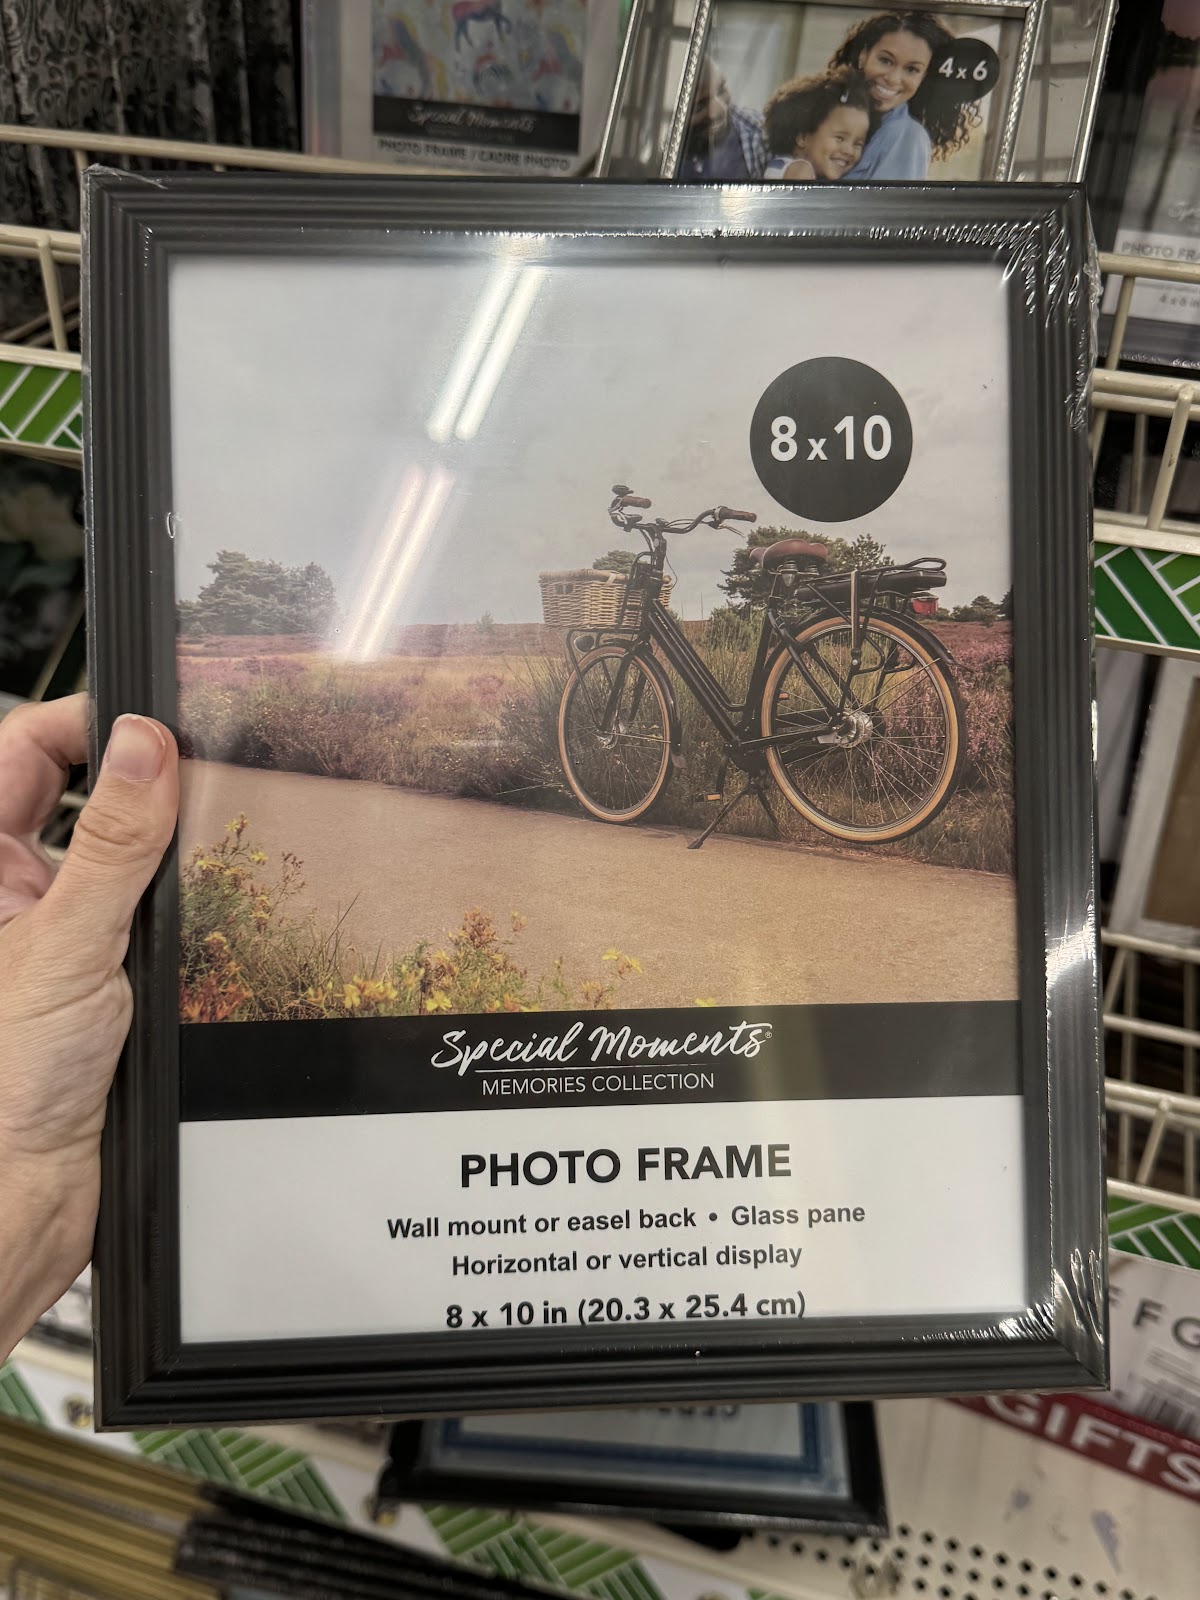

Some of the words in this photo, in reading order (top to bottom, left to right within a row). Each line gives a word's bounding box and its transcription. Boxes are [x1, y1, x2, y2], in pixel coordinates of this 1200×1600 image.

[938, 56, 954, 79] 4
[956, 66, 967, 80] x
[972, 58, 988, 82] 6
[770, 415, 798, 462] 8
[806, 438, 828, 461] x
[833, 414, 892, 461] 10
[430, 1021, 585, 1077] Special
[481, 1076, 587, 1096] MEMORIES
[591, 1072, 715, 1093] COLLECTION
[460, 1147, 622, 1188] PHOTO
[637, 1143, 793, 1182] FRAME
[387, 1217, 440, 1239] Wall
[448, 1213, 527, 1236] mount
[534, 1216, 561, 1233] or
[567, 1209, 631, 1232] easel
[639, 1207, 697, 1229] back
[731, 1205, 800, 1227] Glass
[807, 1206, 866, 1229] pane
[452, 1251, 578, 1276] Horizontal
[586, 1254, 612, 1271] or
[619, 1245, 708, 1270] vertical
[715, 1243, 803, 1270] display
[446, 1304, 463, 1329] 8
[471, 1309, 489, 1328] x
[499, 1301, 535, 1326] 10
[542, 1299, 568, 1325] in
[577, 1295, 651, 1326] (20.3
[658, 1301, 676, 1320] x
[685, 1292, 749, 1319] 25.4
[756, 1290, 806, 1320] cm)
